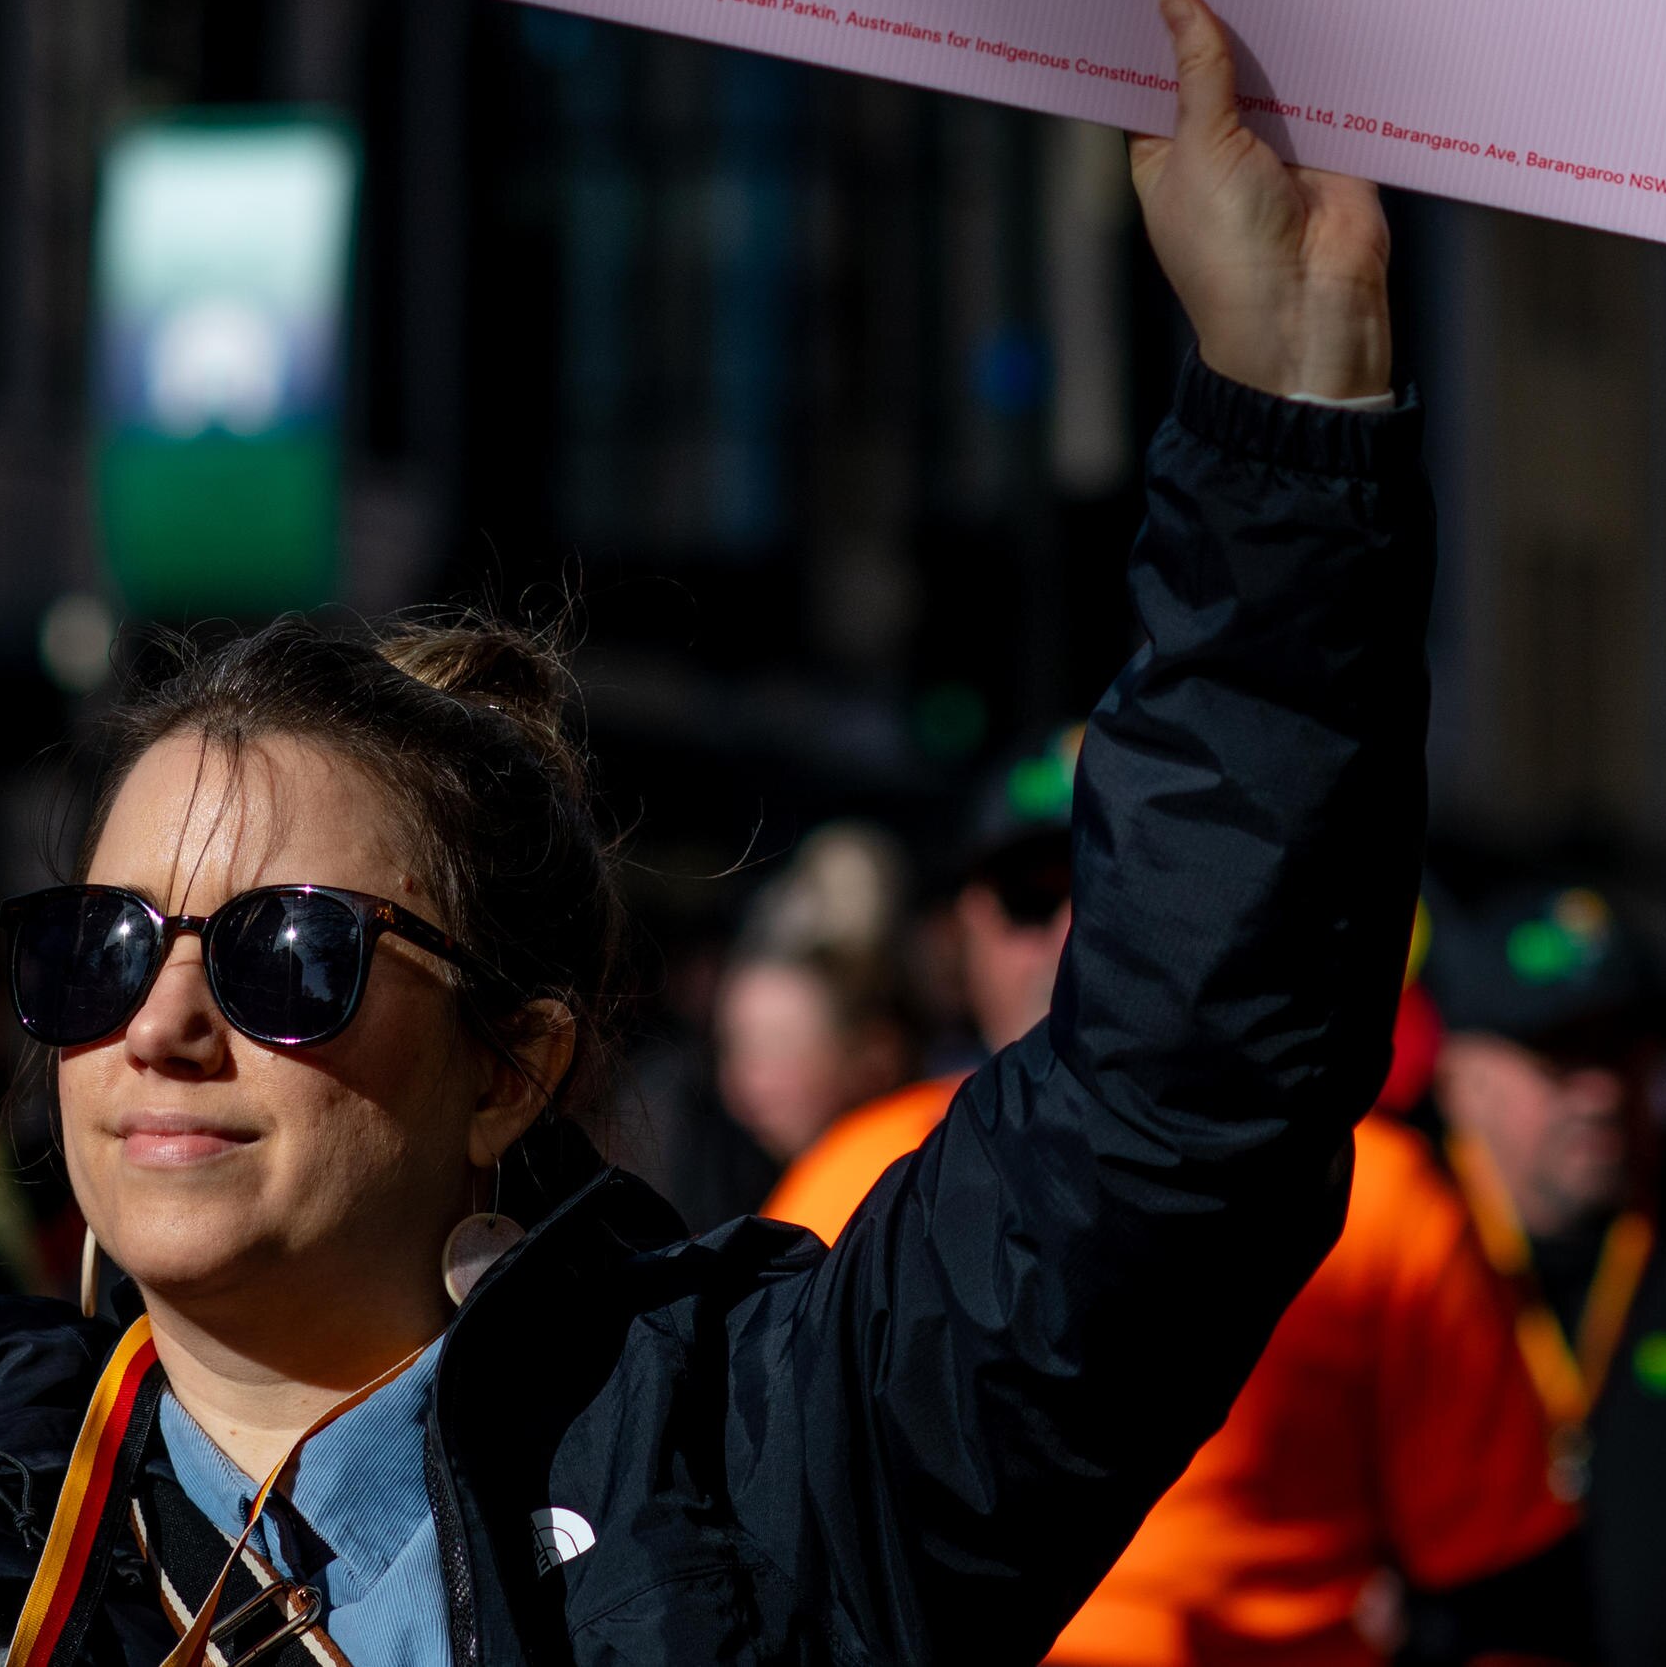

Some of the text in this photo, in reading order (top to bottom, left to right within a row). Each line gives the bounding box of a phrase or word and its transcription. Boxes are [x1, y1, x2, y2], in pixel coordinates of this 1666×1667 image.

[845, 10, 942, 43] Australians
[947, 31, 970, 48] for
[975, 38, 1070, 71] Indigenous
[1075, 58, 1180, 94] Constitution
[1234, 93, 1301, 118] ognition
[1305, 106, 1337, 127] Ltd,
[1342, 113, 1377, 134] 200
[1381, 121, 1481, 155] Barangaroo
[1484, 143, 1520, 166] Ave,
[1526, 151, 1625, 185] Barangaroo
